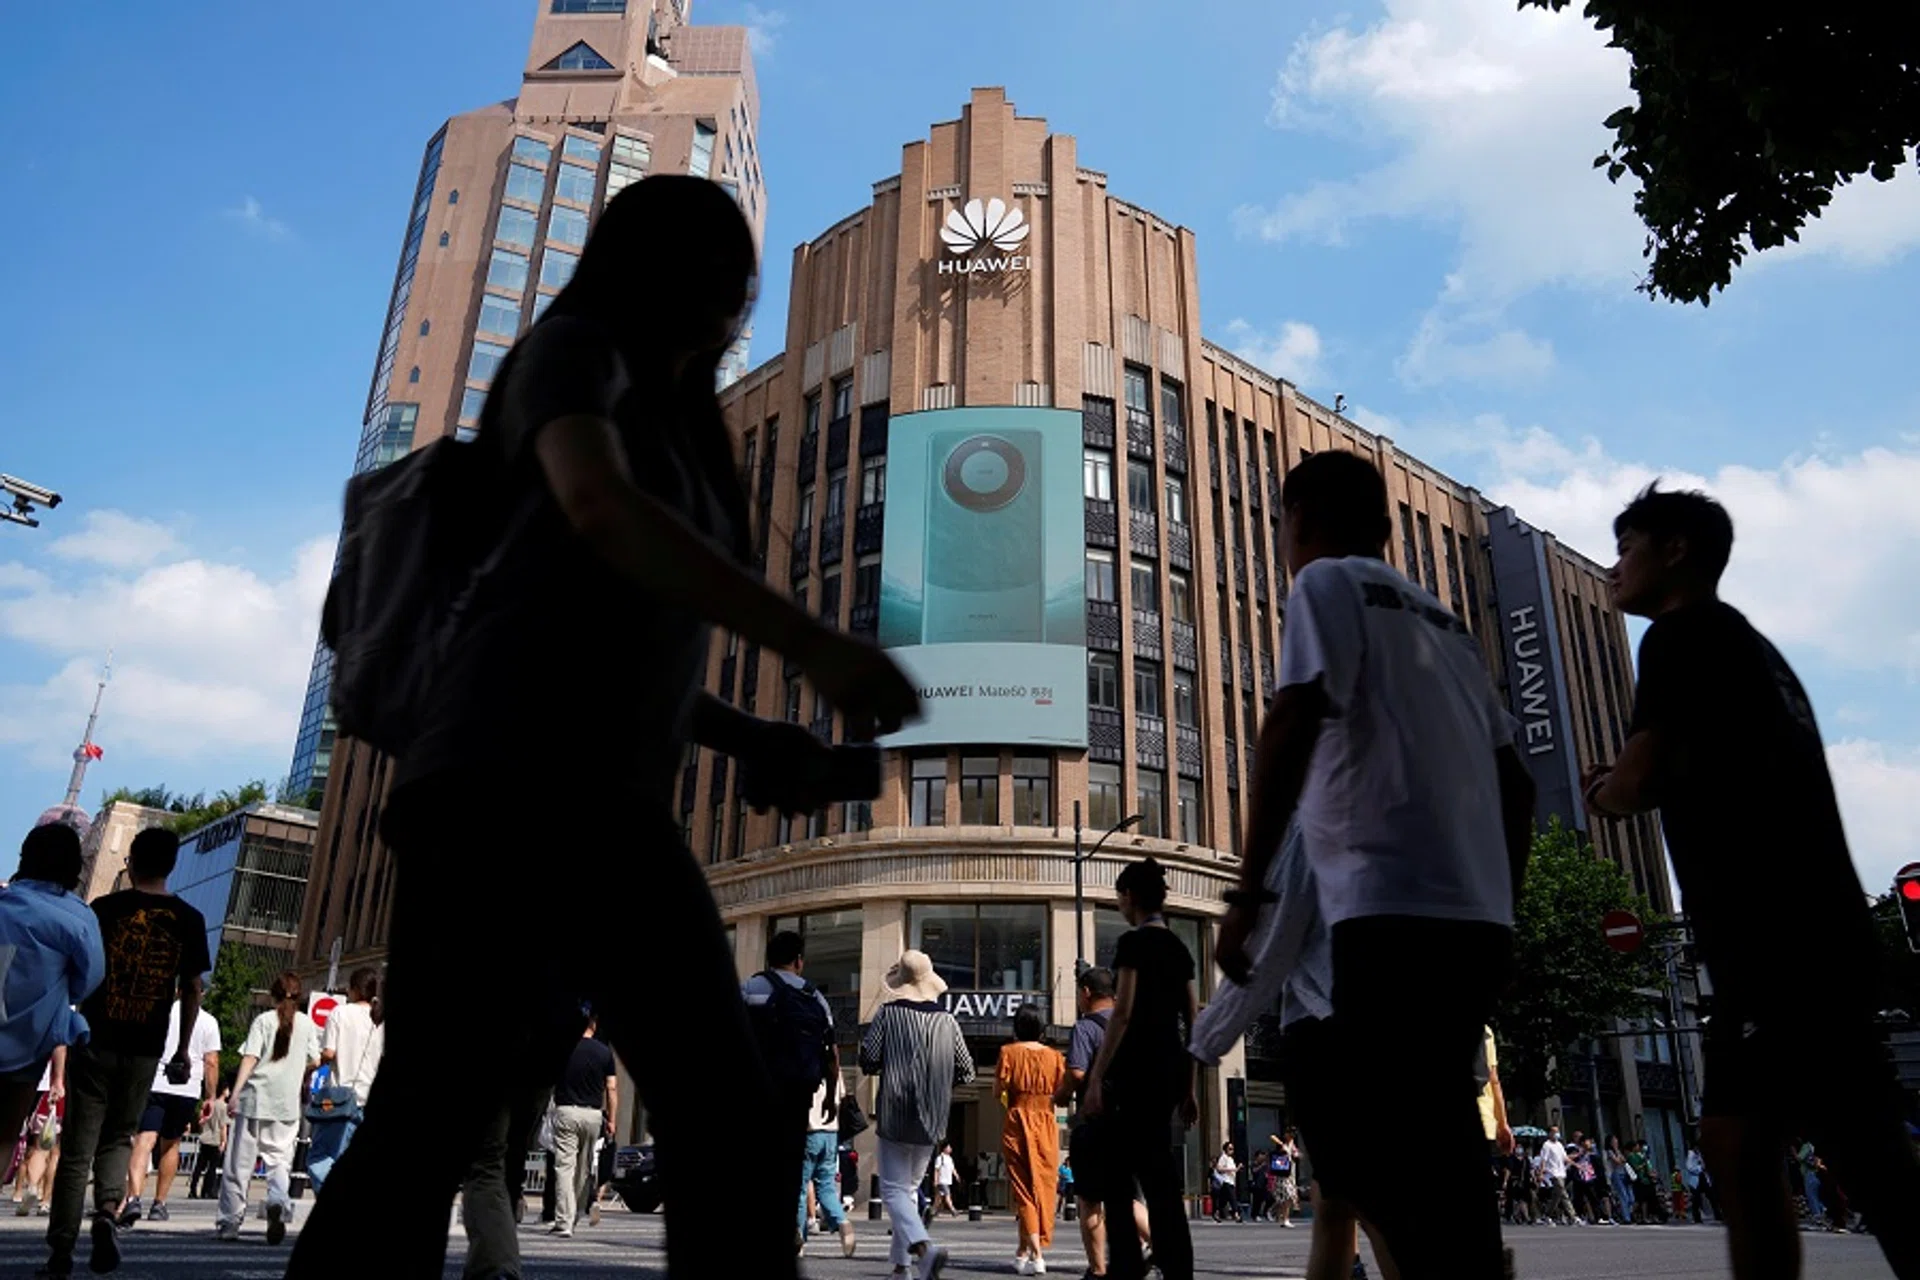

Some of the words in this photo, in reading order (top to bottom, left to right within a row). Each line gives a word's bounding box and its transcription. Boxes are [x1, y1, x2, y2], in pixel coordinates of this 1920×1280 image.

[938, 256, 1030, 274] HUAWEI
[1510, 606, 1554, 754] HUAWEI
[979, 684, 1026, 698] Mate60
